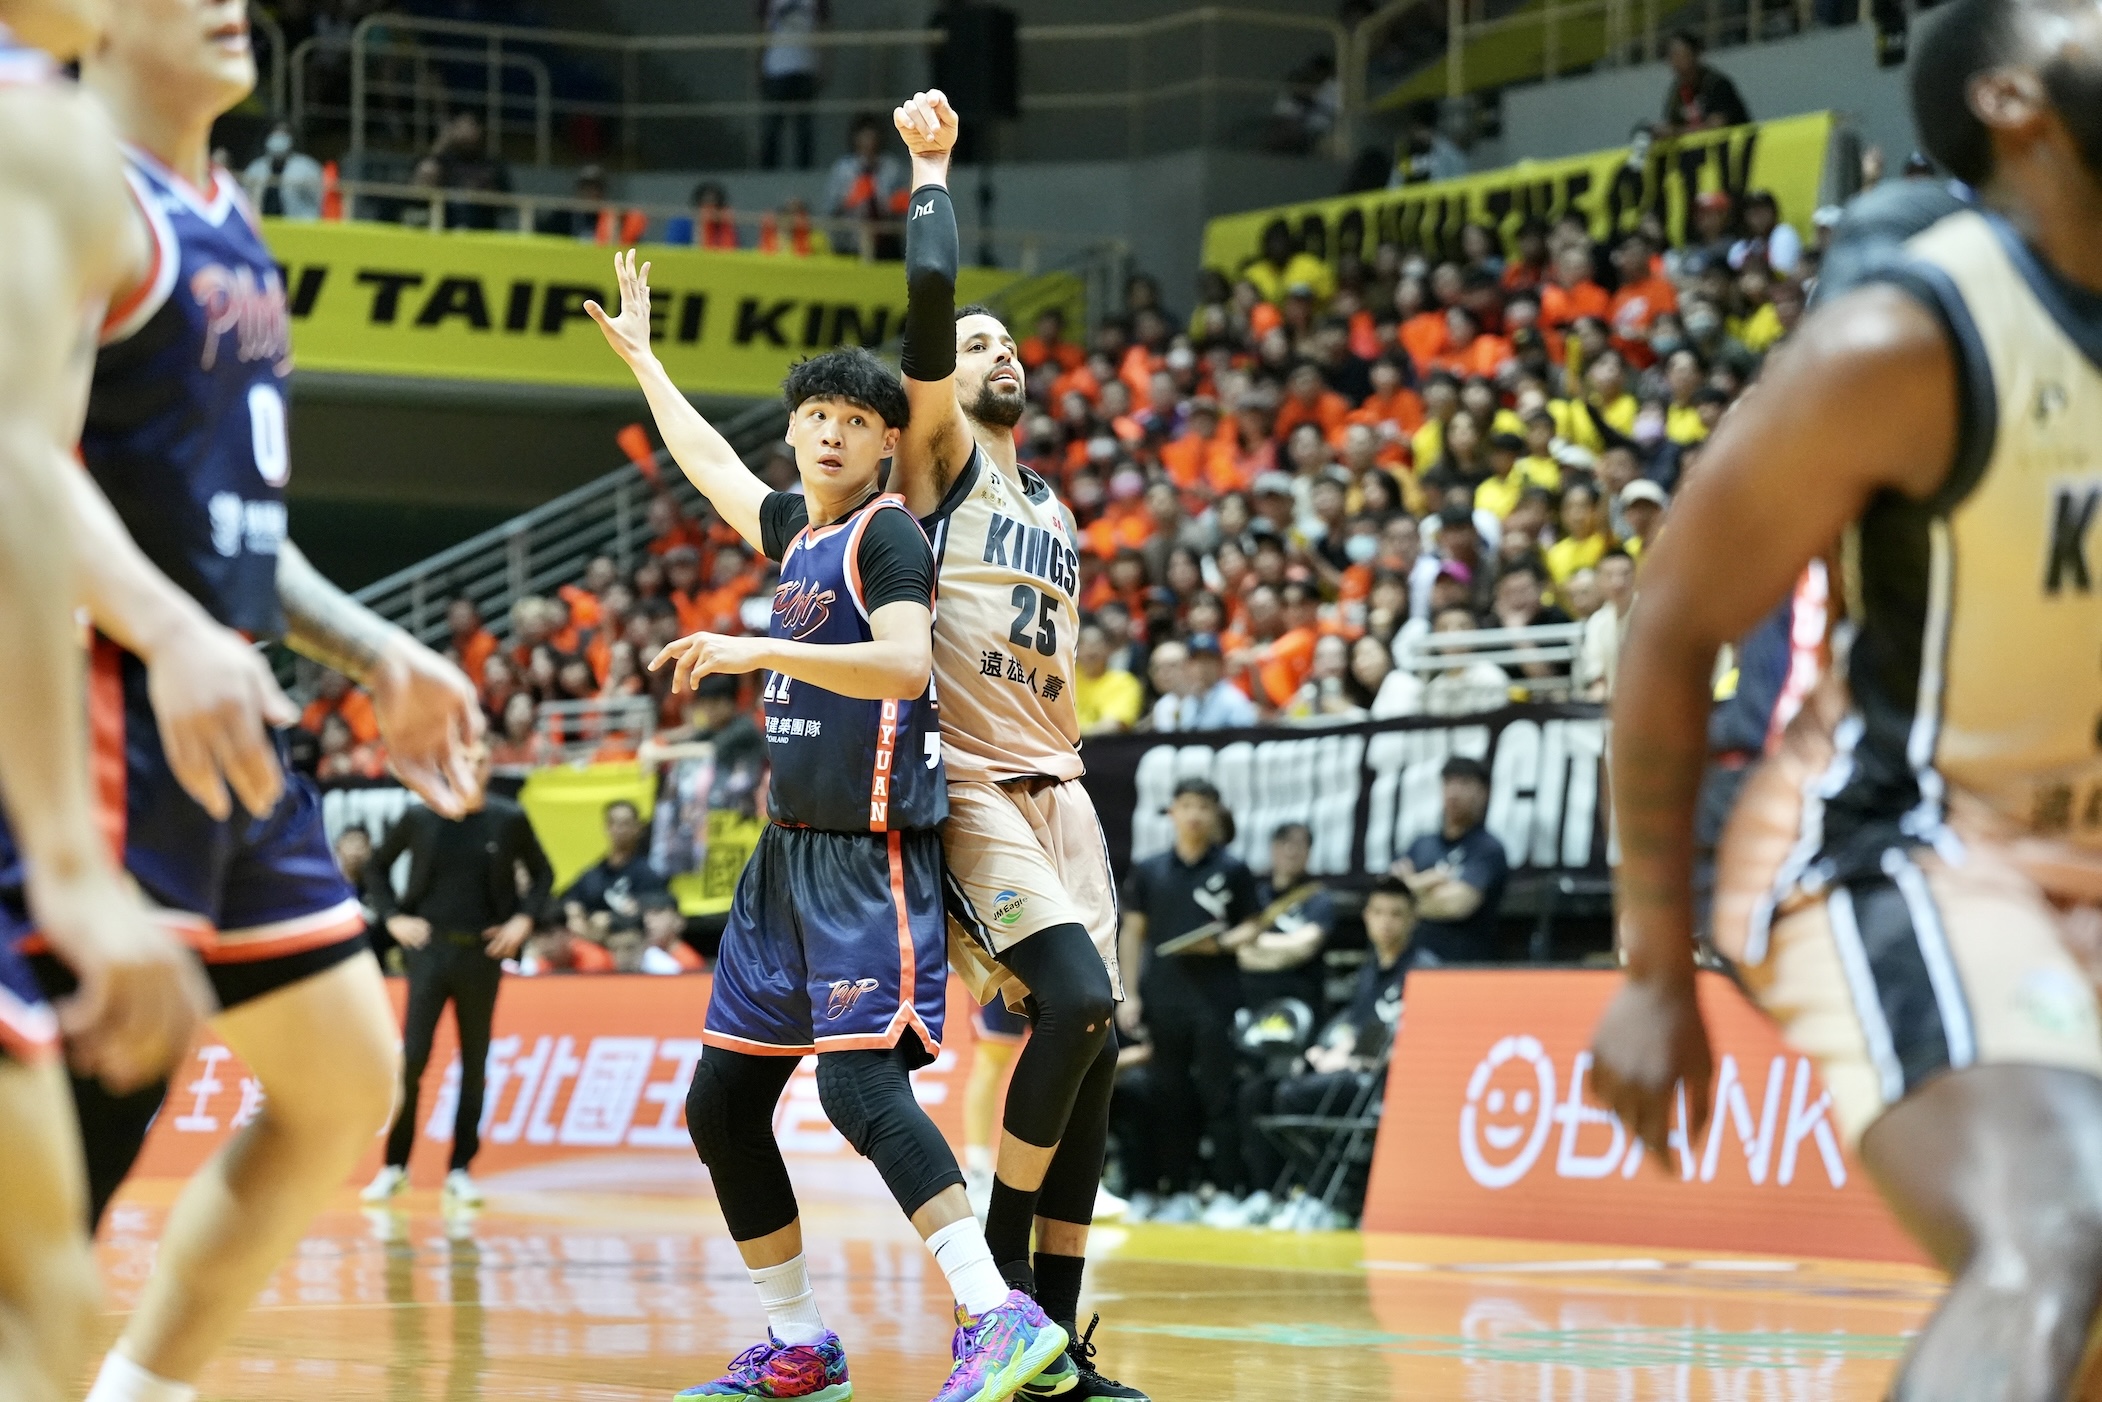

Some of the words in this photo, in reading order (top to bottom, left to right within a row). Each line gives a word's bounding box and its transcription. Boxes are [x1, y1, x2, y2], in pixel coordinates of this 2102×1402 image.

[983, 511, 1078, 598] KINGS
[1009, 584, 1059, 657] 25
[979, 650, 1066, 702] 遠雄人壽
[1003, 897, 1028, 913] Eagle
